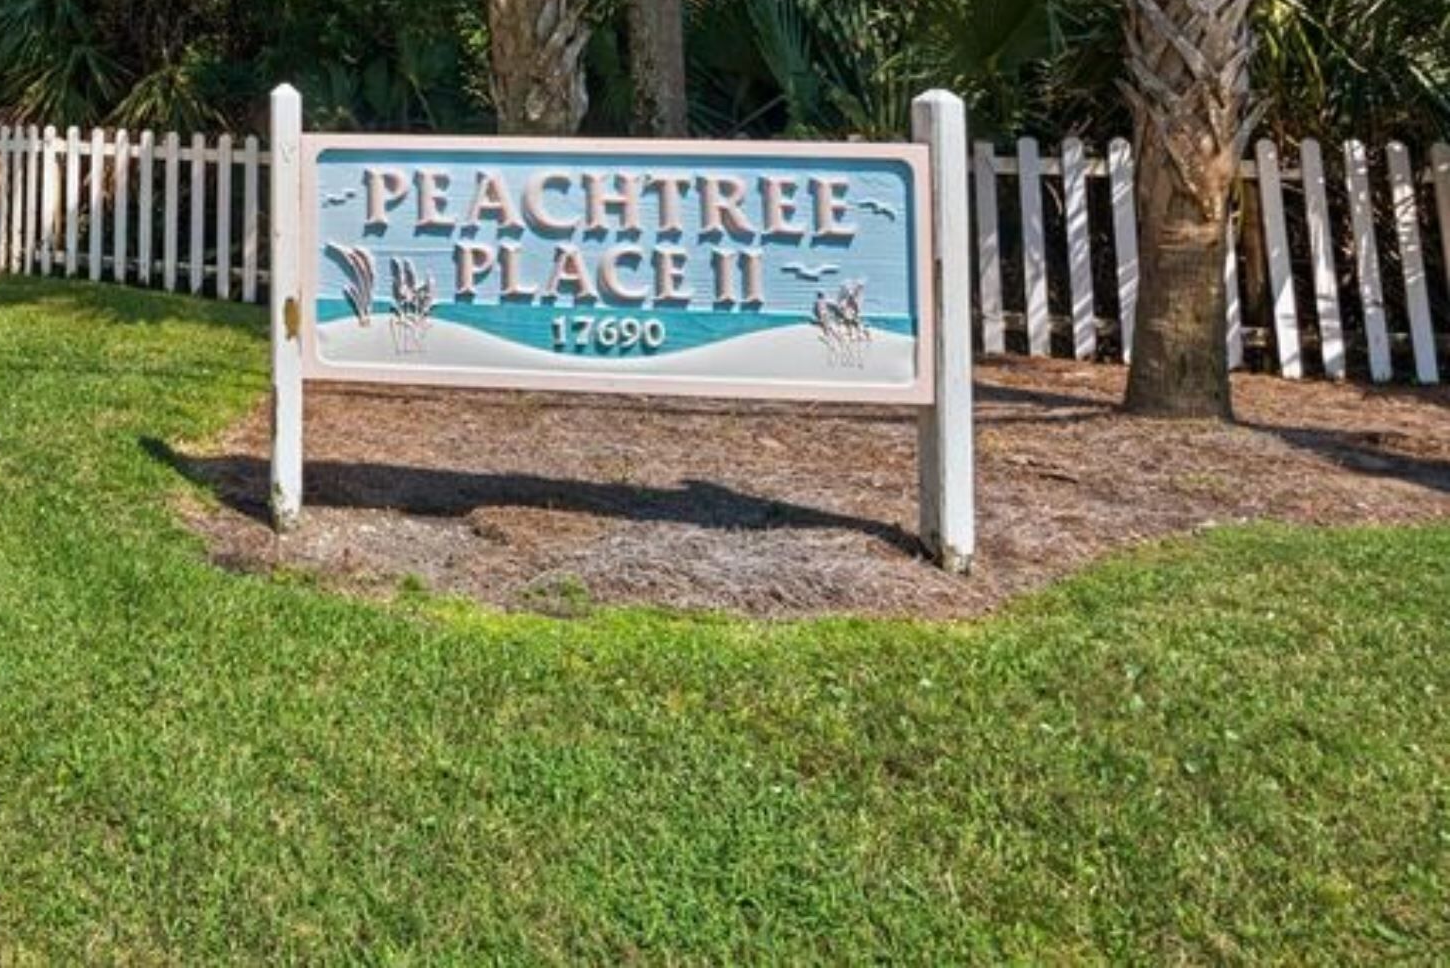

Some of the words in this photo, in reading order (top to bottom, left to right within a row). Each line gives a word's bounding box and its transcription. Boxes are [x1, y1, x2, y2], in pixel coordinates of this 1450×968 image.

[363, 167, 858, 243] PEACHTREE
[454, 242, 696, 306] PLACE
[712, 247, 764, 309] II
[552, 317, 666, 351] 17690
